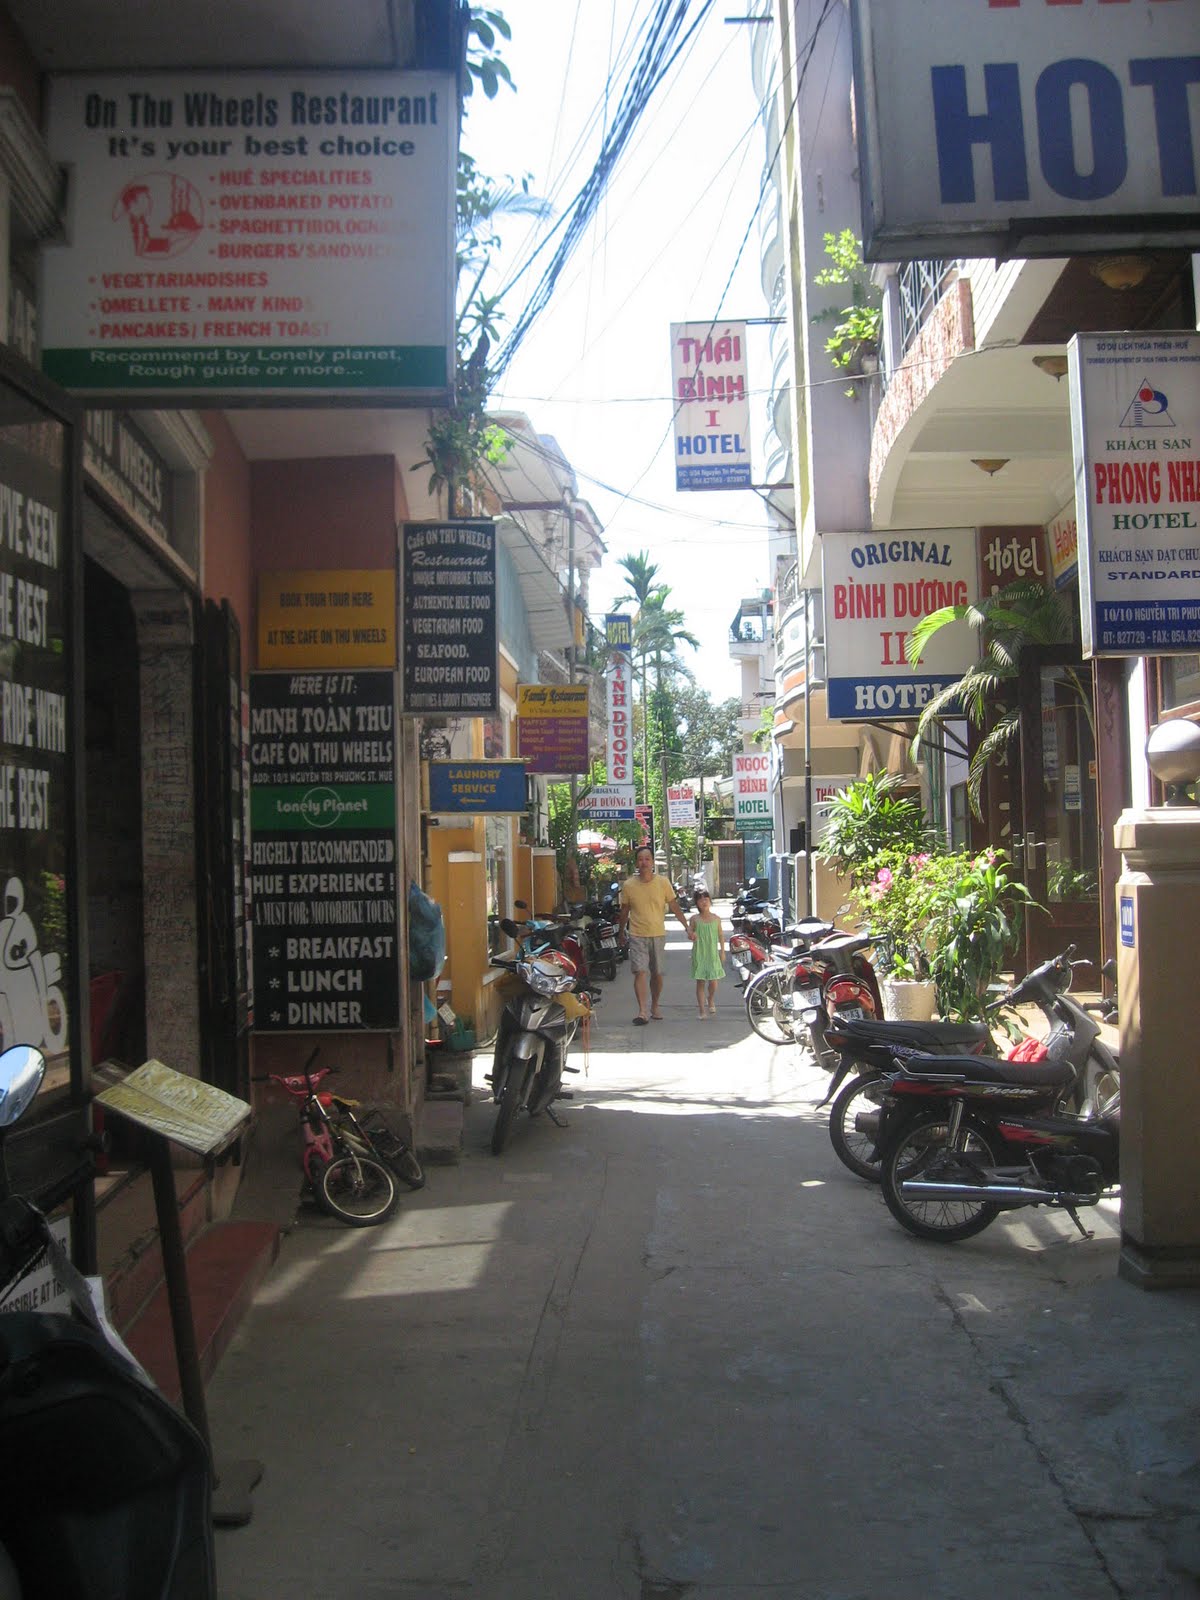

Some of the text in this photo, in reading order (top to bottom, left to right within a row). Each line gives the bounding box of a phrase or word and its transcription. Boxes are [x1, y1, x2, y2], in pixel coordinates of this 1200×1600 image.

[83, 91, 438, 129] On Thu Wheels Restaurant
[931, 57, 1200, 205] HOT
[108, 135, 416, 160] It's your best choice
[260, 169, 373, 185] SPECIALITIES
[219, 195, 321, 211] OVENBAKED
[100, 296, 315, 314] OMELLETE MANY KIND
[203, 322, 272, 338] FRENCH
[91, 350, 219, 363] Recommend
[225, 349, 250, 364] by
[257, 349, 324, 363] Lonely
[677, 329, 740, 364] THÁI
[128, 364, 195, 378] Rough
[202, 364, 260, 378] guide
[266, 366, 289, 376] or
[677, 370, 745, 404] BÌNH
[705, 410, 720, 427] I
[678, 434, 746, 456] HOTEL
[1094, 461, 1161, 505] PHONG
[1112, 512, 1197, 530] HOTEL
[27, 498, 58, 569] SEEN
[426, 529, 438, 545] ON
[440, 528, 457, 544] THU
[458, 529, 492, 551] WHEELS
[411, 550, 488, 566] Restaurant
[851, 540, 953, 569] ORIGINAL
[984, 537, 1044, 577] Hotel
[1107, 570, 1200, 581] STANDARD
[304, 592, 327, 608] YOUR
[328, 592, 350, 607] TOUR
[471, 595, 490, 610] FOOD
[833, 576, 886, 620] BÌNH
[17, 577, 48, 648] REST
[268, 628, 387, 645] AT THE CAFE ON THU WHEELS
[412, 618, 484, 635] VEGETARIAN FOOD
[880, 632, 924, 665] II
[290, 676, 322, 694] HERE
[325, 676, 338, 694] IS
[414, 666, 490, 683] EUROPEAN FOOD
[2, 680, 66, 753] RIDE WITH
[356, 704, 392, 733] THU
[251, 740, 393, 766] CAFE ON THU WHEELS
[448, 769, 502, 779] LAUNDRY
[18, 767, 49, 830] BEST
[452, 784, 497, 793] SERVICE
[277, 799, 368, 816] Lonely Planet
[590, 810, 621, 818] HOTEL
[738, 800, 770, 814] HOTEL
[253, 840, 394, 865] HIGHLY RECOMMENDED
[253, 875, 284, 894] HUE
[289, 873, 384, 893] EXPERIENCE
[264, 902, 287, 925] MUST
[366, 900, 395, 923] TOURS
[286, 937, 393, 960] BREAKFAST
[287, 969, 363, 992] LUNCH
[287, 1001, 362, 1025] DINNER
[982, 1086, 1040, 1095] Dream
